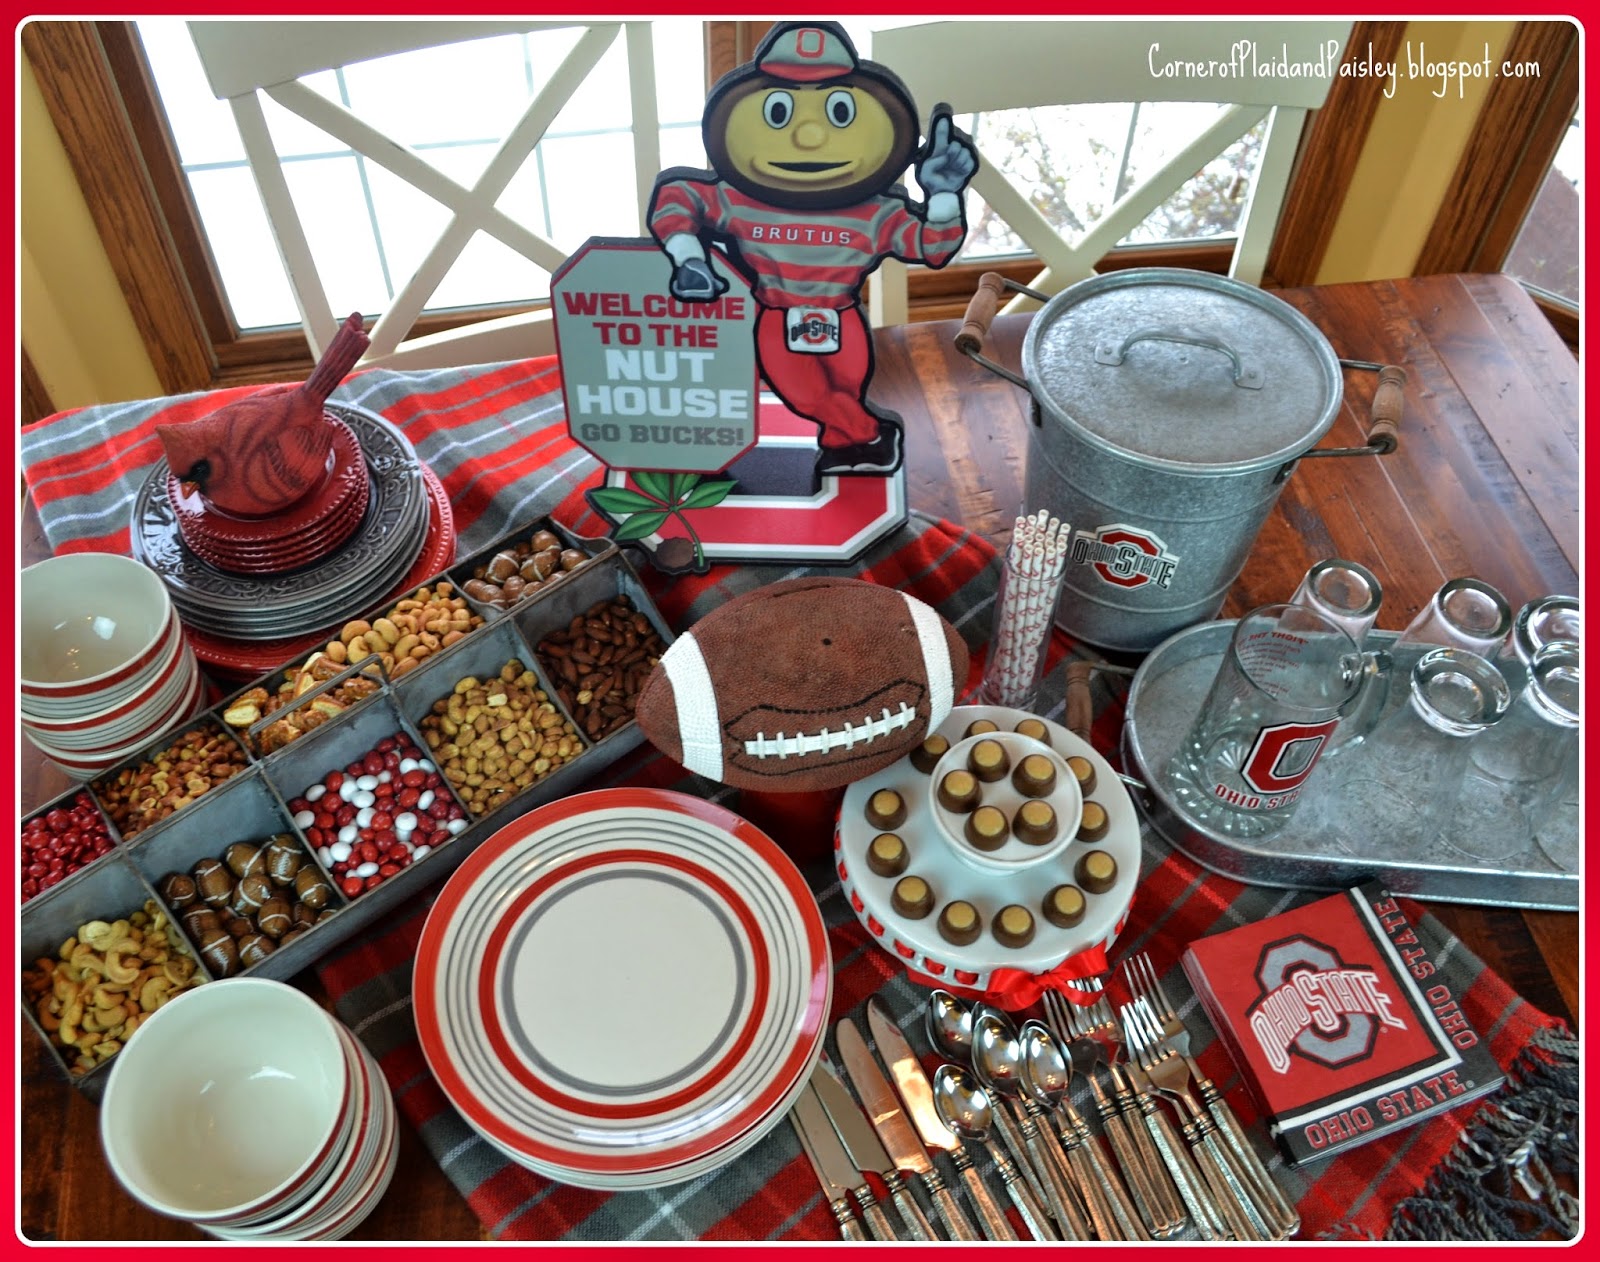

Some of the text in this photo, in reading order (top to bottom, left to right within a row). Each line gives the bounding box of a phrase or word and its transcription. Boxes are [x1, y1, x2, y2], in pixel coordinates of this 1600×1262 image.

[752, 226, 851, 245] BRUTUS
[562, 291, 746, 321] WELCOME
[592, 321, 719, 348] TO THE
[604, 348, 716, 383] NUT
[576, 384, 749, 420] HOUSE
[580, 422, 745, 446] GO BUCKS!
[1215, 783, 1303, 810] OHIO STA
[1372, 898, 1479, 1050] OHIO STATE
[1304, 1069, 1467, 1150] OHIO STATE
